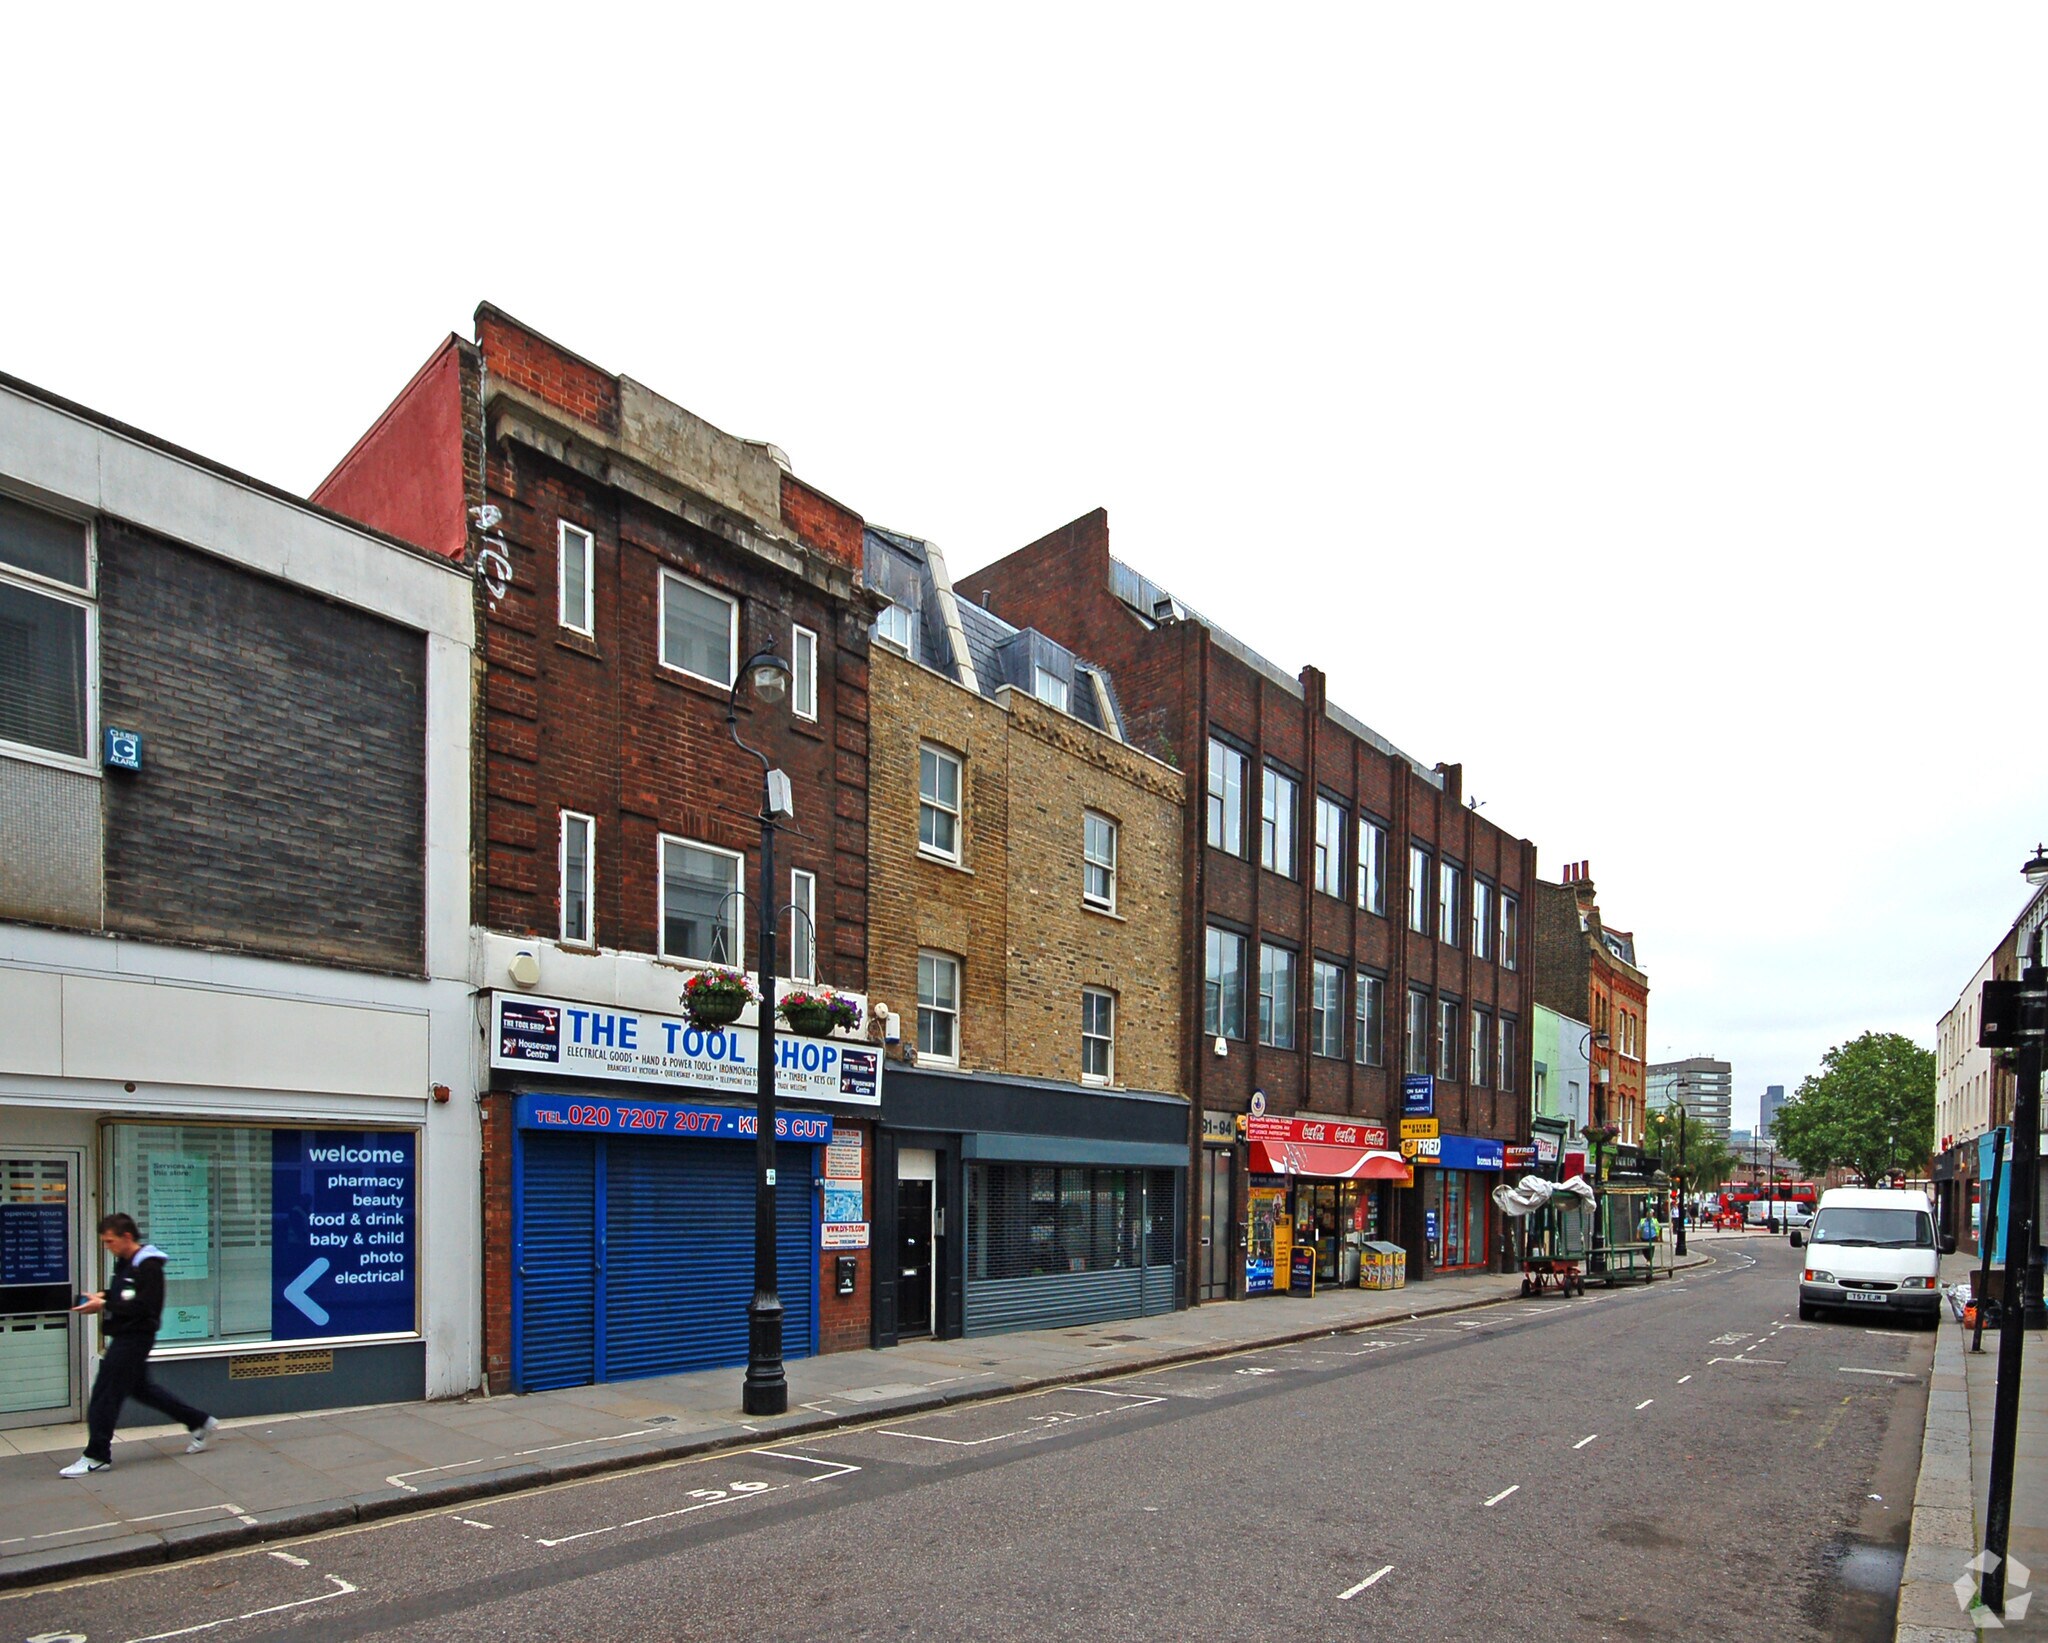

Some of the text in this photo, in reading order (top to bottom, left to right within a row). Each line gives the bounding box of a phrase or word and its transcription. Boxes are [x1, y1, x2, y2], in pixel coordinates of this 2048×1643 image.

[515, 1020, 529, 1029] TOOL
[530, 1022, 545, 1031] SHOP
[567, 1009, 638, 1050] THE
[661, 1022, 745, 1063] TOOL
[518, 1038, 557, 1052] Houseware
[526, 1048, 549, 1059] Centre
[567, 1046, 607, 1060] ELECTRICAL
[609, 1051, 632, 1063] GOODS
[642, 1055, 660, 1067] HAND
[662, 1057, 667, 1066] &
[670, 1058, 692, 1069] POWER
[694, 1060, 712, 1072] TOOLS
[788, 1072, 807, 1082] TIMBER
[826, 1077, 836, 1086] CUT
[617, 1107, 669, 1130] 7207
[674, 1111, 723, 1132] 2077
[792, 1119, 828, 1138] CUT
[1302, 1123, 1385, 1146] Coca-Cola Coca-Cola Coca-Cola
[309, 1145, 404, 1163] welcome
[1477, 1155, 1503, 1168] bonus king
[328, 1174, 404, 1189] pharmacy
[352, 1194, 404, 1208] beauty
[309, 1213, 404, 1226] food & drink
[310, 1231, 404, 1248] baby & child
[360, 1251, 404, 1266] photo
[335, 1269, 404, 1284] electrical
[685, 1480, 769, 1501] 56
